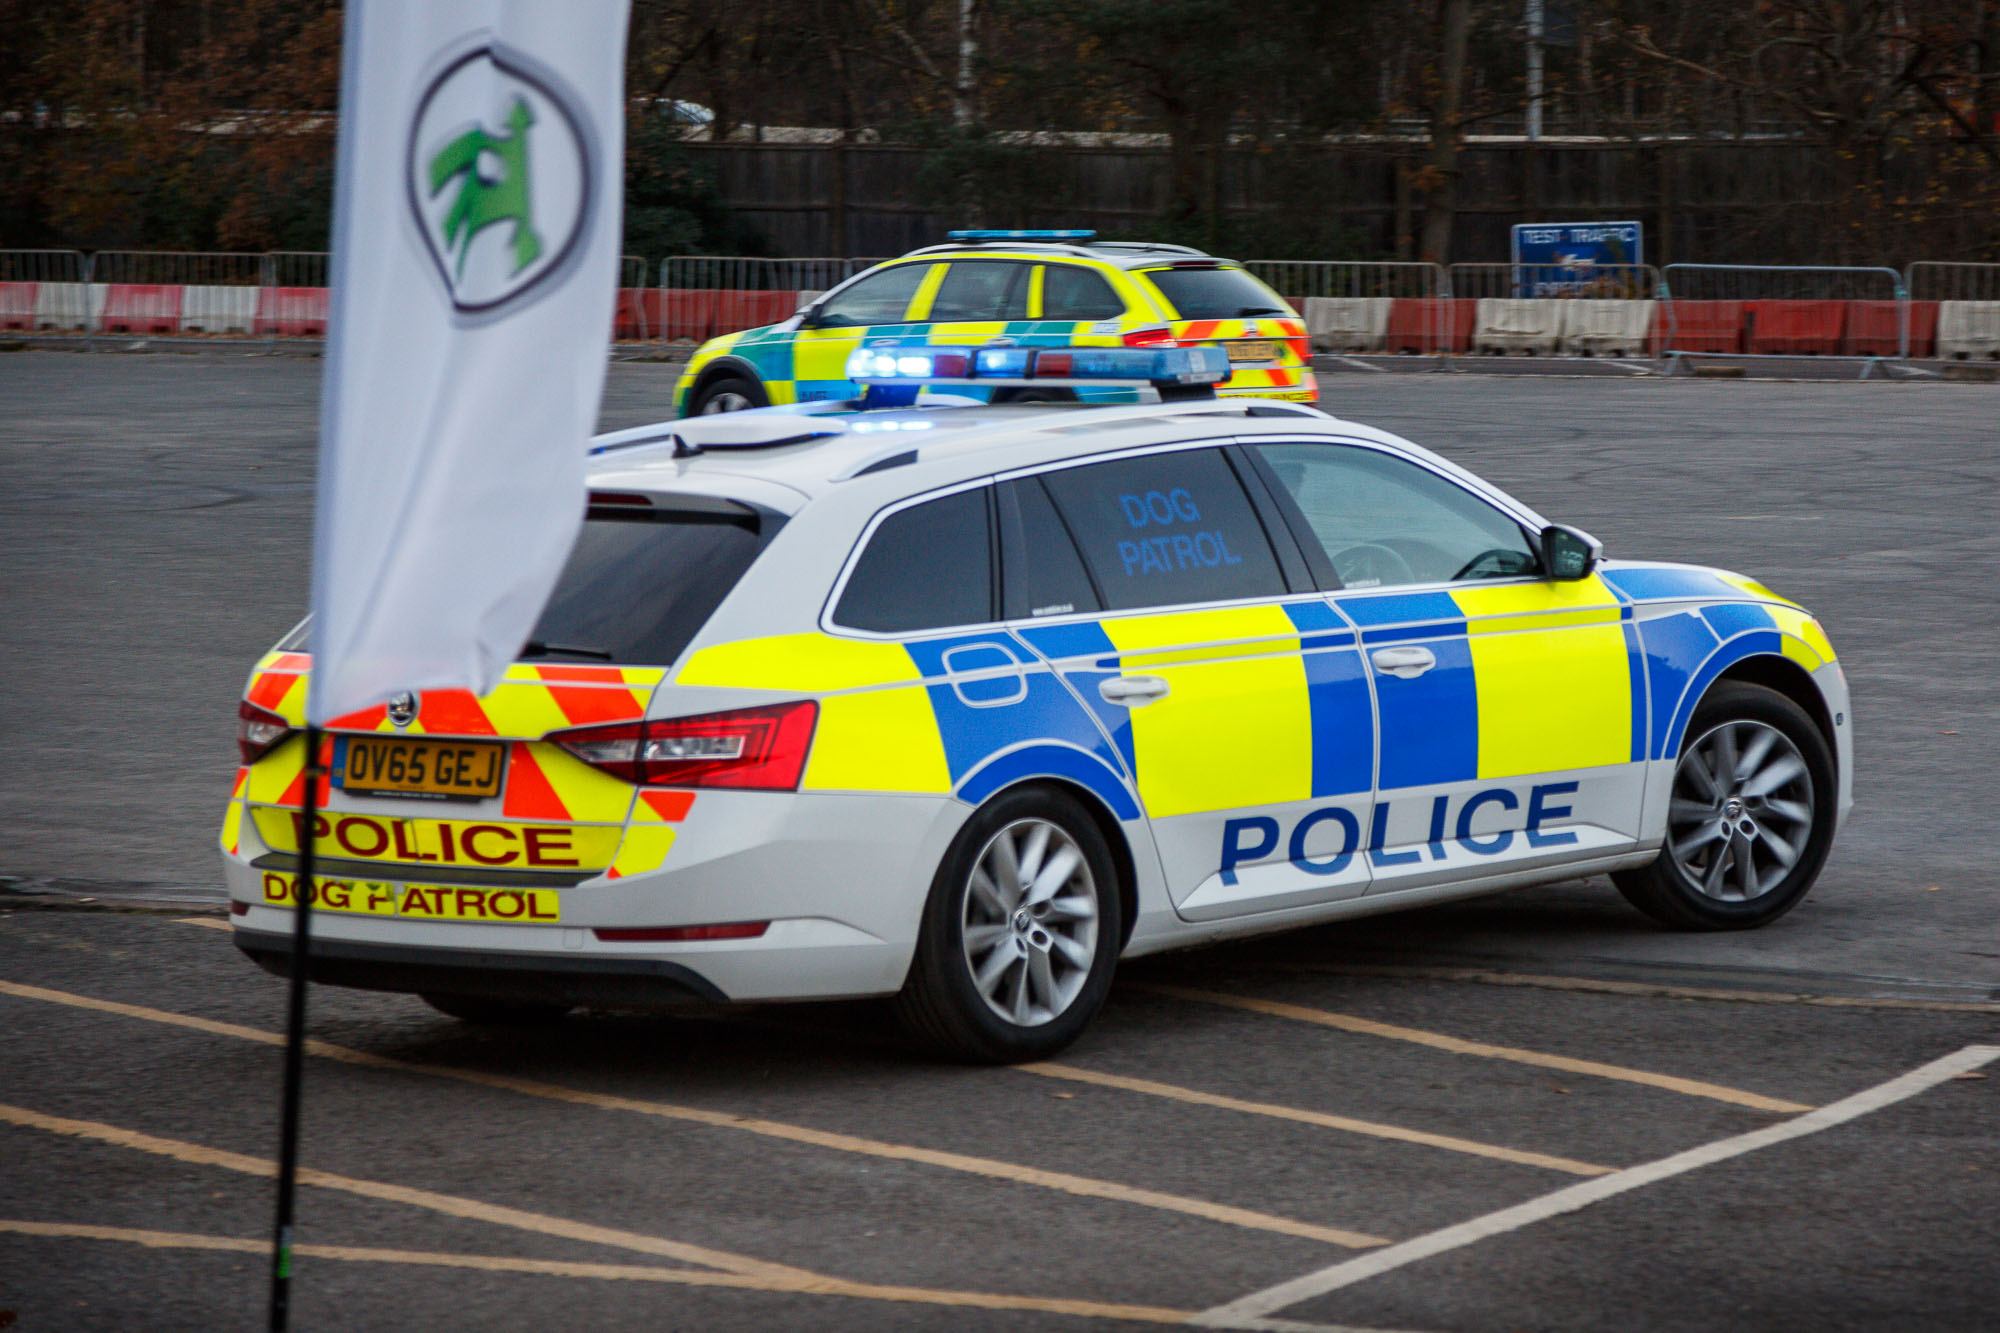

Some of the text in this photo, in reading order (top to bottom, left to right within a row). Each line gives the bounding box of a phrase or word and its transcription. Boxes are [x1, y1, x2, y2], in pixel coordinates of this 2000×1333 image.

[1520, 229, 1564, 244] TEST
[1119, 487, 1201, 528] DOG
[1117, 530, 1242, 576] PATROL
[350, 743, 497, 788] OV65 GEJ
[290, 811, 580, 867] POLICE
[1219, 780, 1580, 886] POLICE
